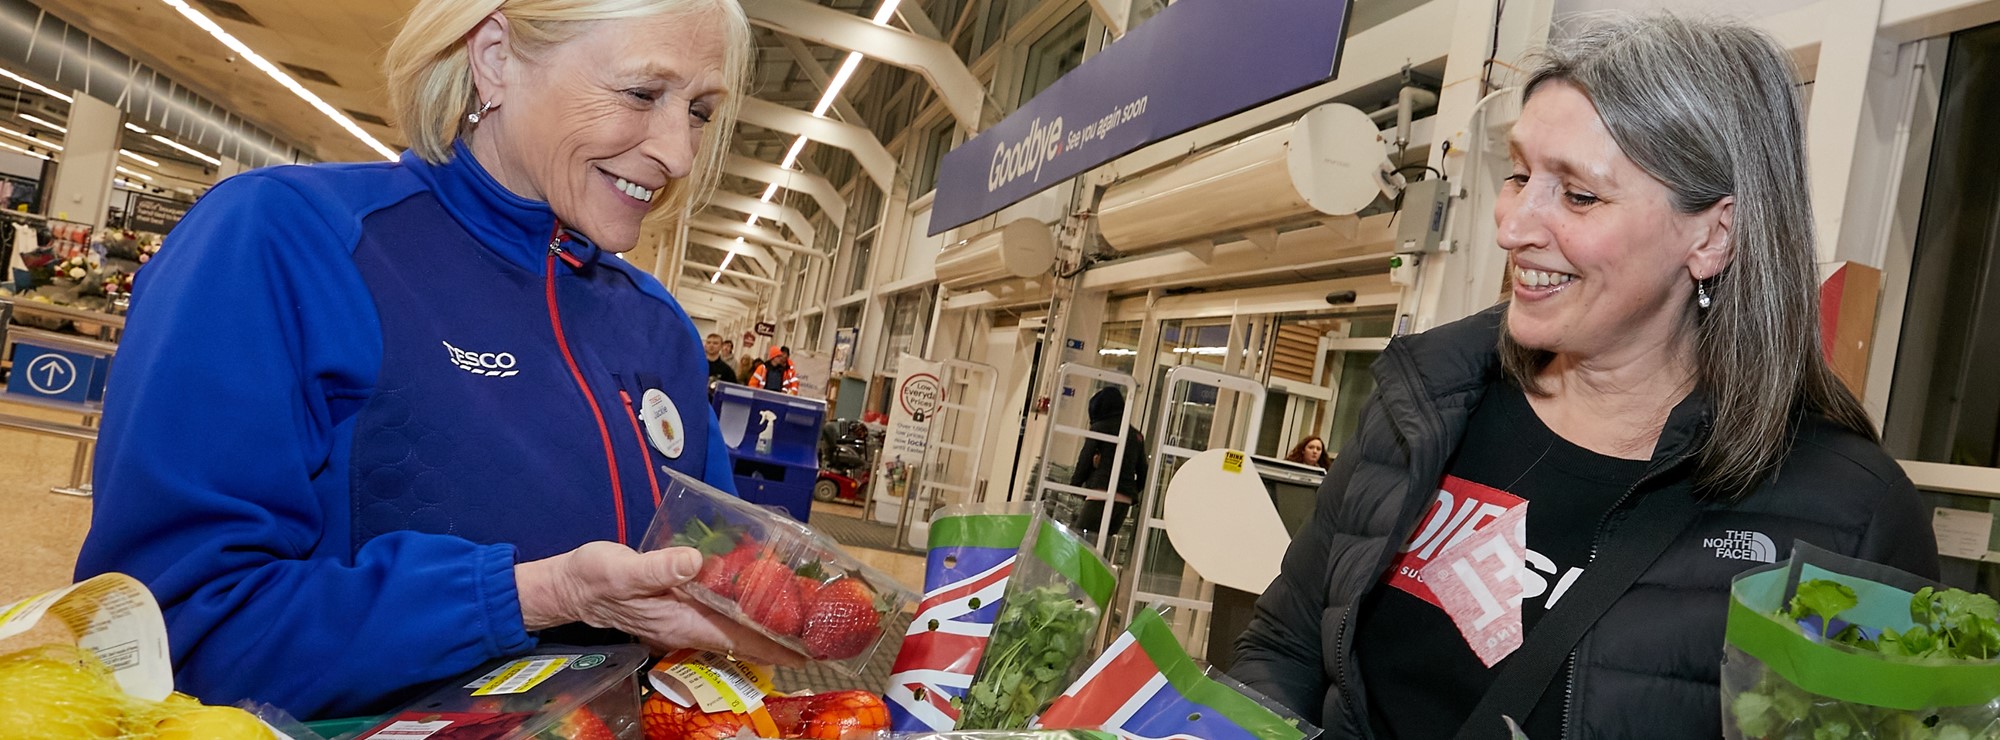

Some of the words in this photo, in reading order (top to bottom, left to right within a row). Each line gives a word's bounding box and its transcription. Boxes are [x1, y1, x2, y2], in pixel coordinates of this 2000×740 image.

[988, 116, 1063, 192] Goodbye.
[1066, 130, 1081, 152] See
[1079, 125, 1096, 150] you
[1096, 106, 1121, 140] again
[1121, 95, 1148, 124] soon
[442, 340, 516, 369] TESCO
[917, 383, 931, 391] Low
[910, 398, 932, 408] Prices
[1725, 529, 1753, 540] THE
[1703, 538, 1752, 550] NORTH
[1715, 548, 1751, 560] FACE
